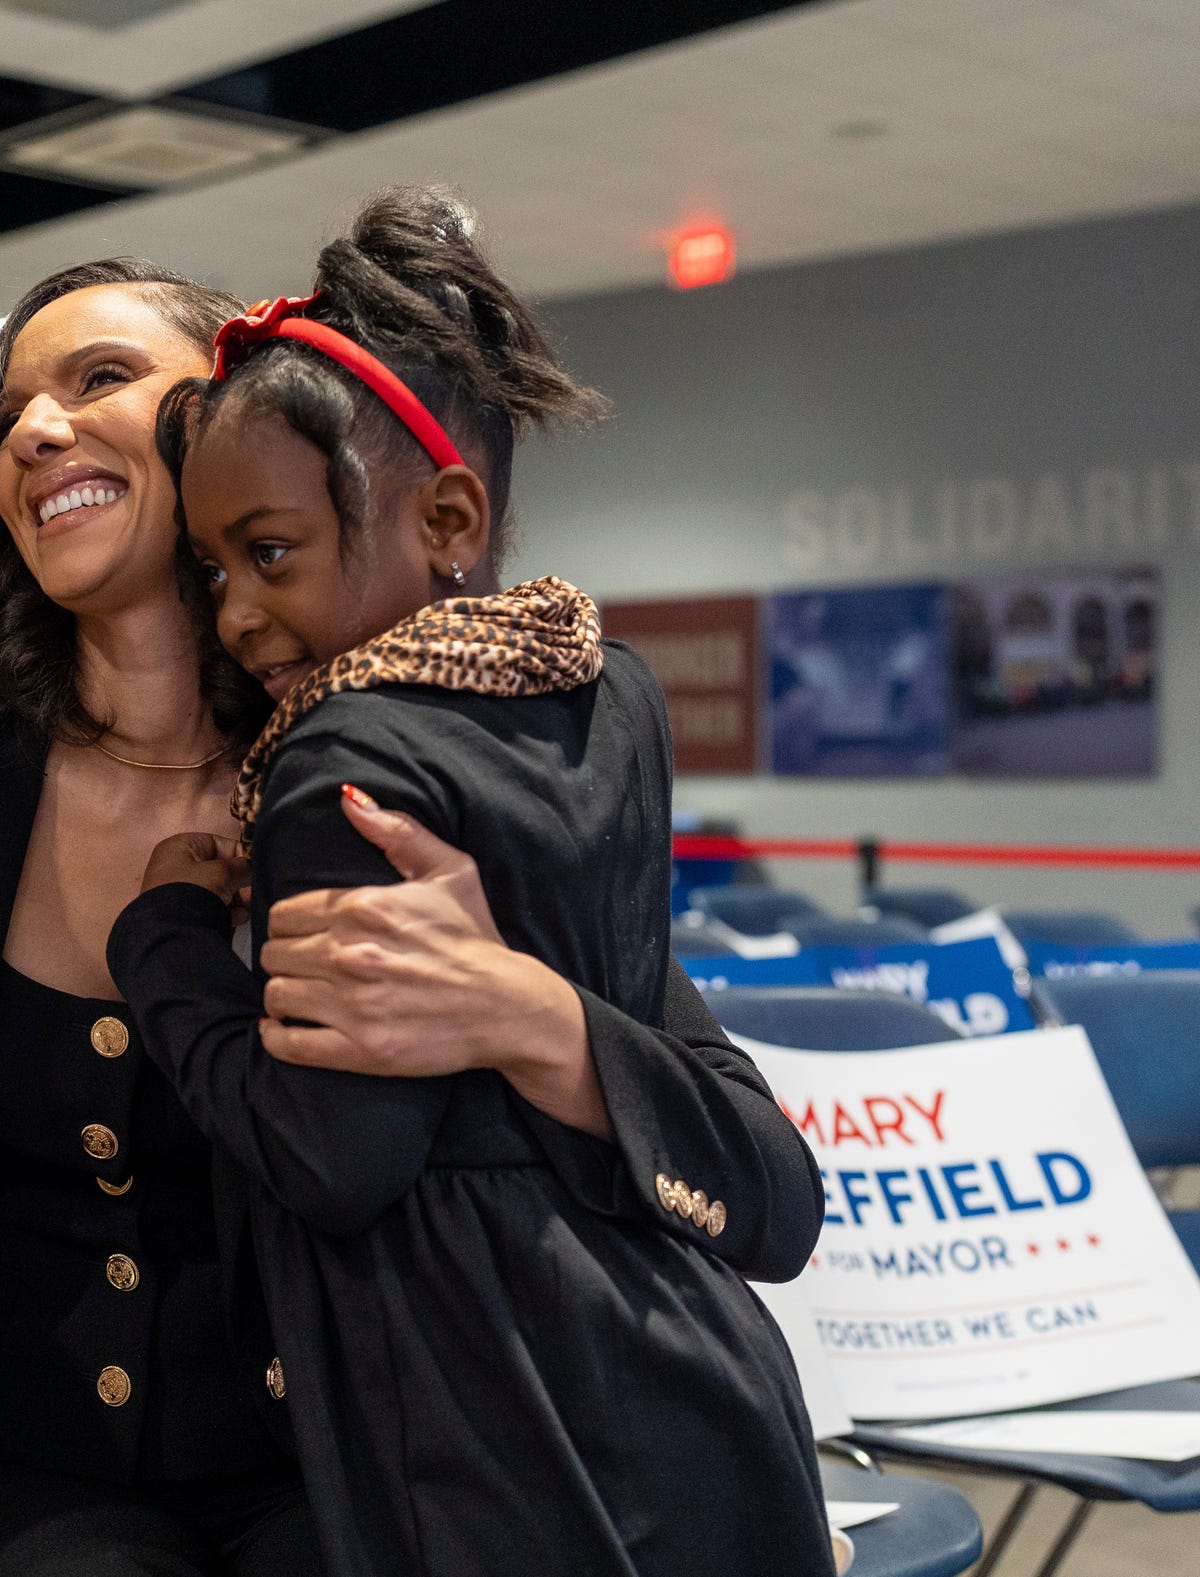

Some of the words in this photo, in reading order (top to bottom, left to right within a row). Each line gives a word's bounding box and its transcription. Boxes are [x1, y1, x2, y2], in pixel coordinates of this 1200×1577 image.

[869, 1235, 1013, 1279] MAYOR
[815, 1316, 953, 1349] TOGETHER
[963, 1311, 1015, 1340] WE
[1026, 1299, 1099, 1333] CAN
